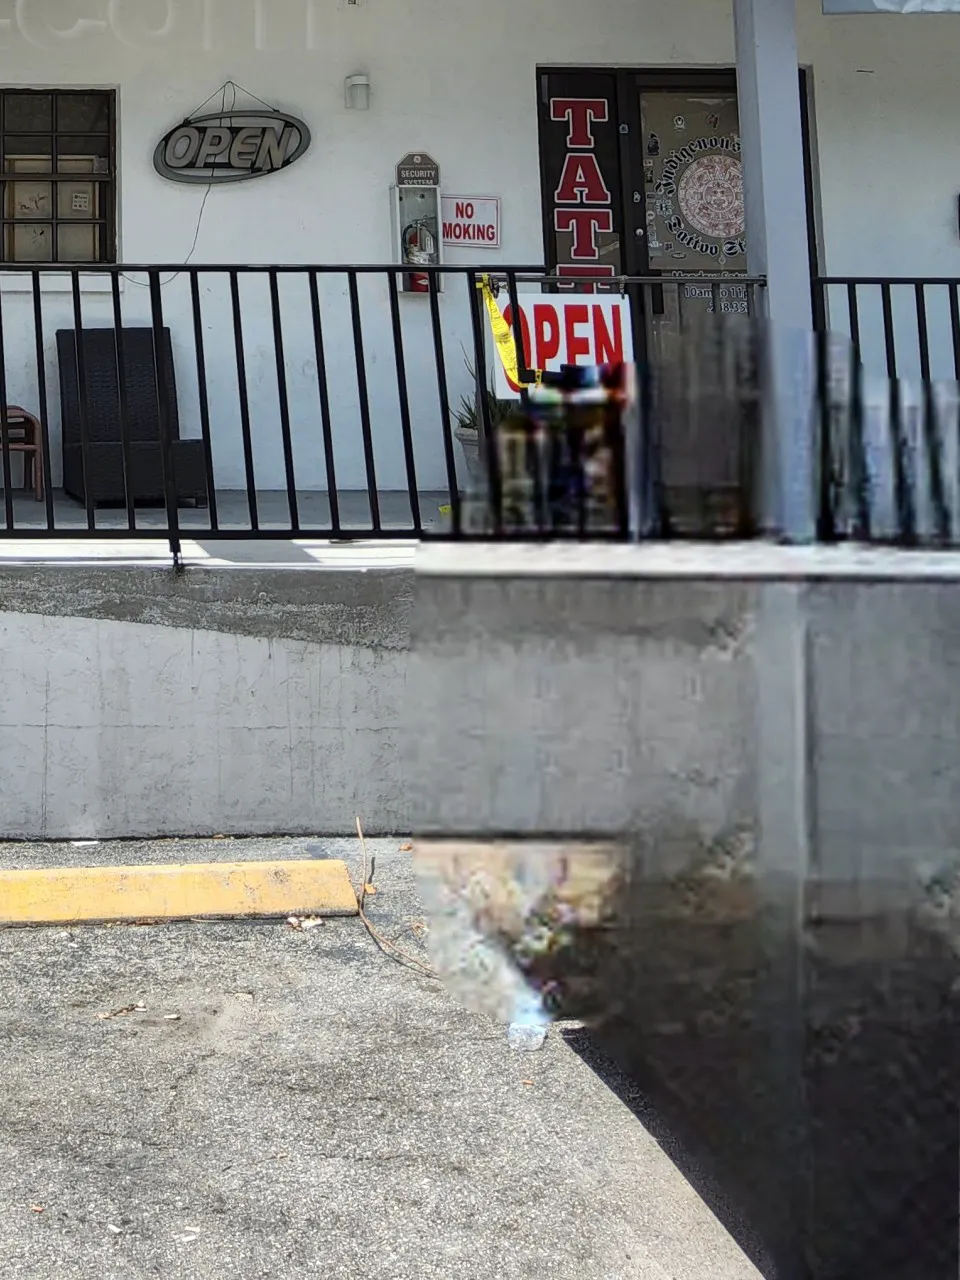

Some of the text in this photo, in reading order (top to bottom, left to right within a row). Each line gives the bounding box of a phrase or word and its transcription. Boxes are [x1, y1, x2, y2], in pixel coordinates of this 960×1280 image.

[165, 126, 294, 170] OPEN
[401, 169, 436, 178] SECURITY
[455, 202, 474, 219] NO
[442, 222, 496, 241] MOKING
